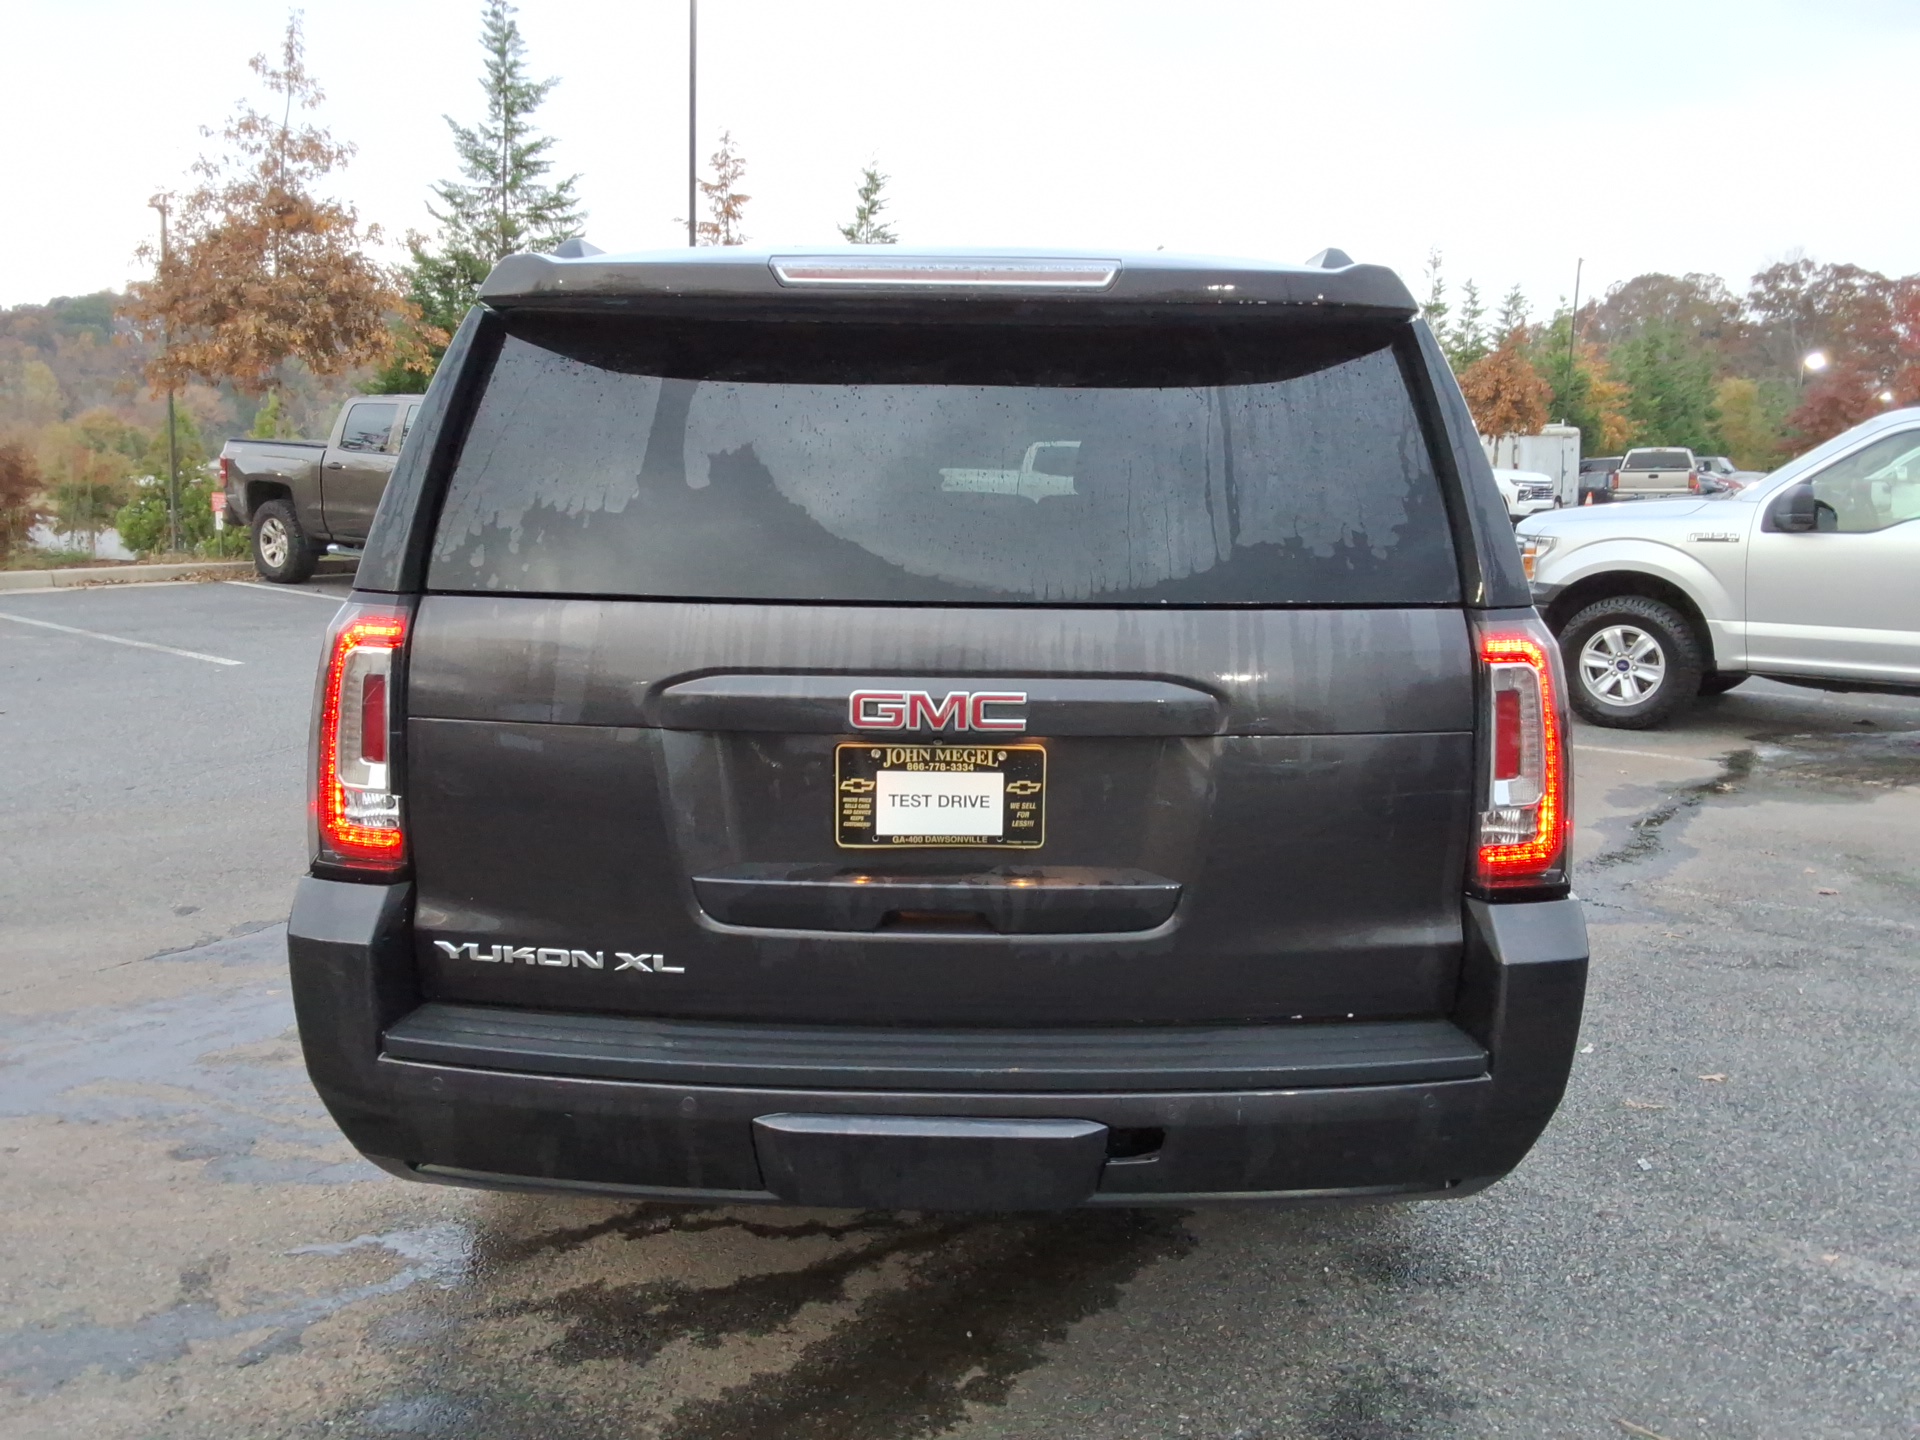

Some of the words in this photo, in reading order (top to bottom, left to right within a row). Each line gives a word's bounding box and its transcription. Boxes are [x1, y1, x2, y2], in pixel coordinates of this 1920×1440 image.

[850, 690, 1027, 731] GMC
[883, 748, 931, 768] JOHN
[935, 749, 999, 767] MEGEL
[888, 793, 933, 808] TEST
[937, 794, 991, 809] DRIVE
[925, 835, 988, 844] DAWSONVILLE
[433, 940, 604, 970] YUKON
[614, 952, 685, 973] XL
